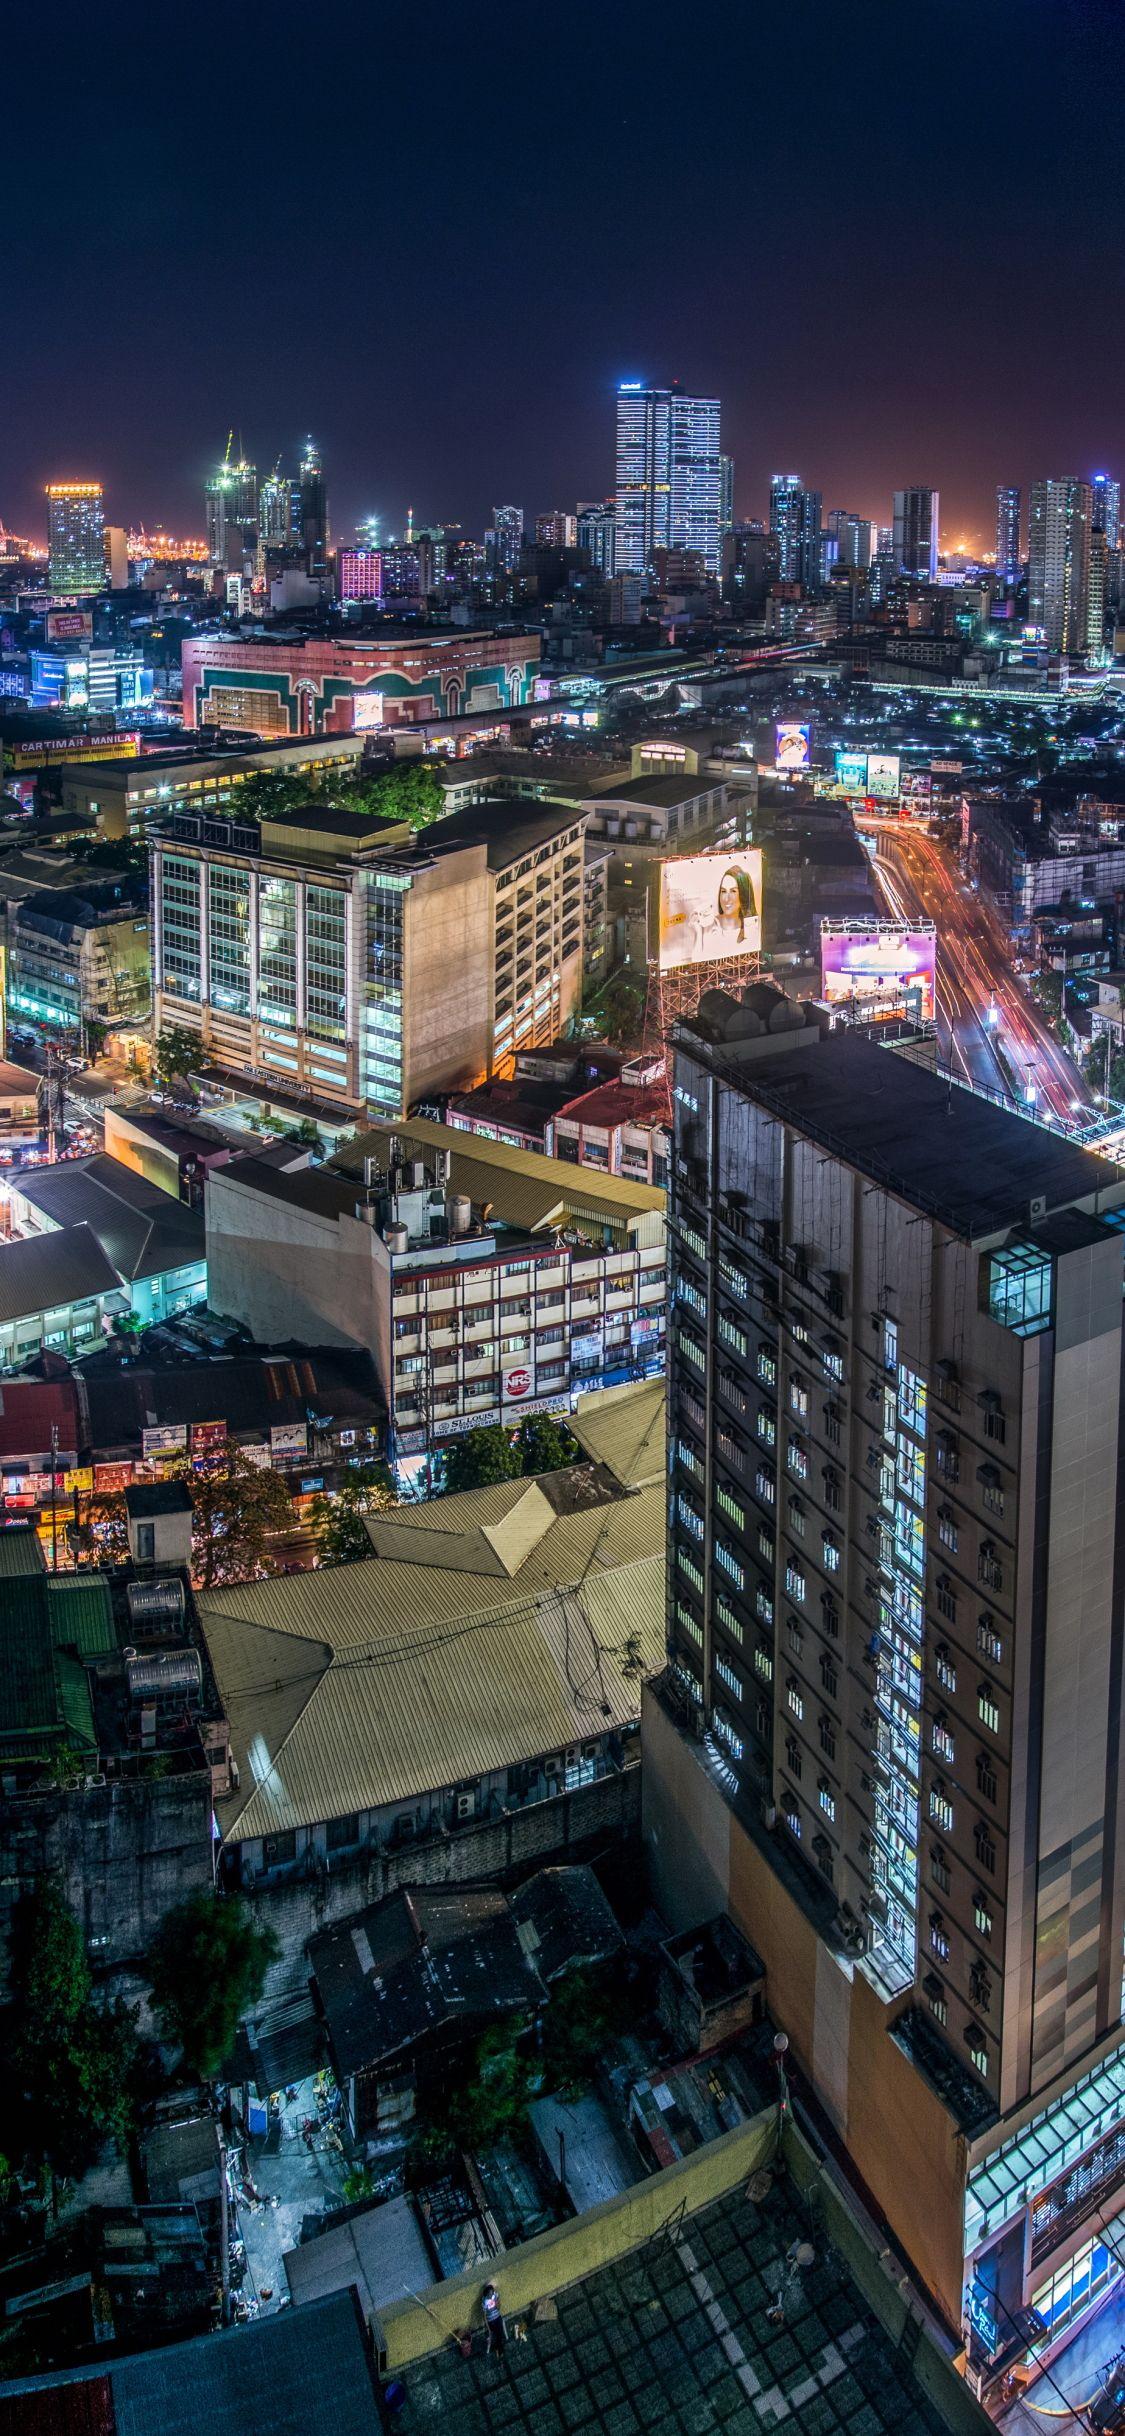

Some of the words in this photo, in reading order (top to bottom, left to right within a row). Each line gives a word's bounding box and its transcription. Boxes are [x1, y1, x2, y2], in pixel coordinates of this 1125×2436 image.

[21, 739, 84, 752] CARTIMAR
[91, 735, 131, 745] MANILA
[279, 1075, 310, 1092] UNIVERSITY
[505, 1373, 531, 1387] NRS
[466, 1412, 494, 1423] LOUIS
